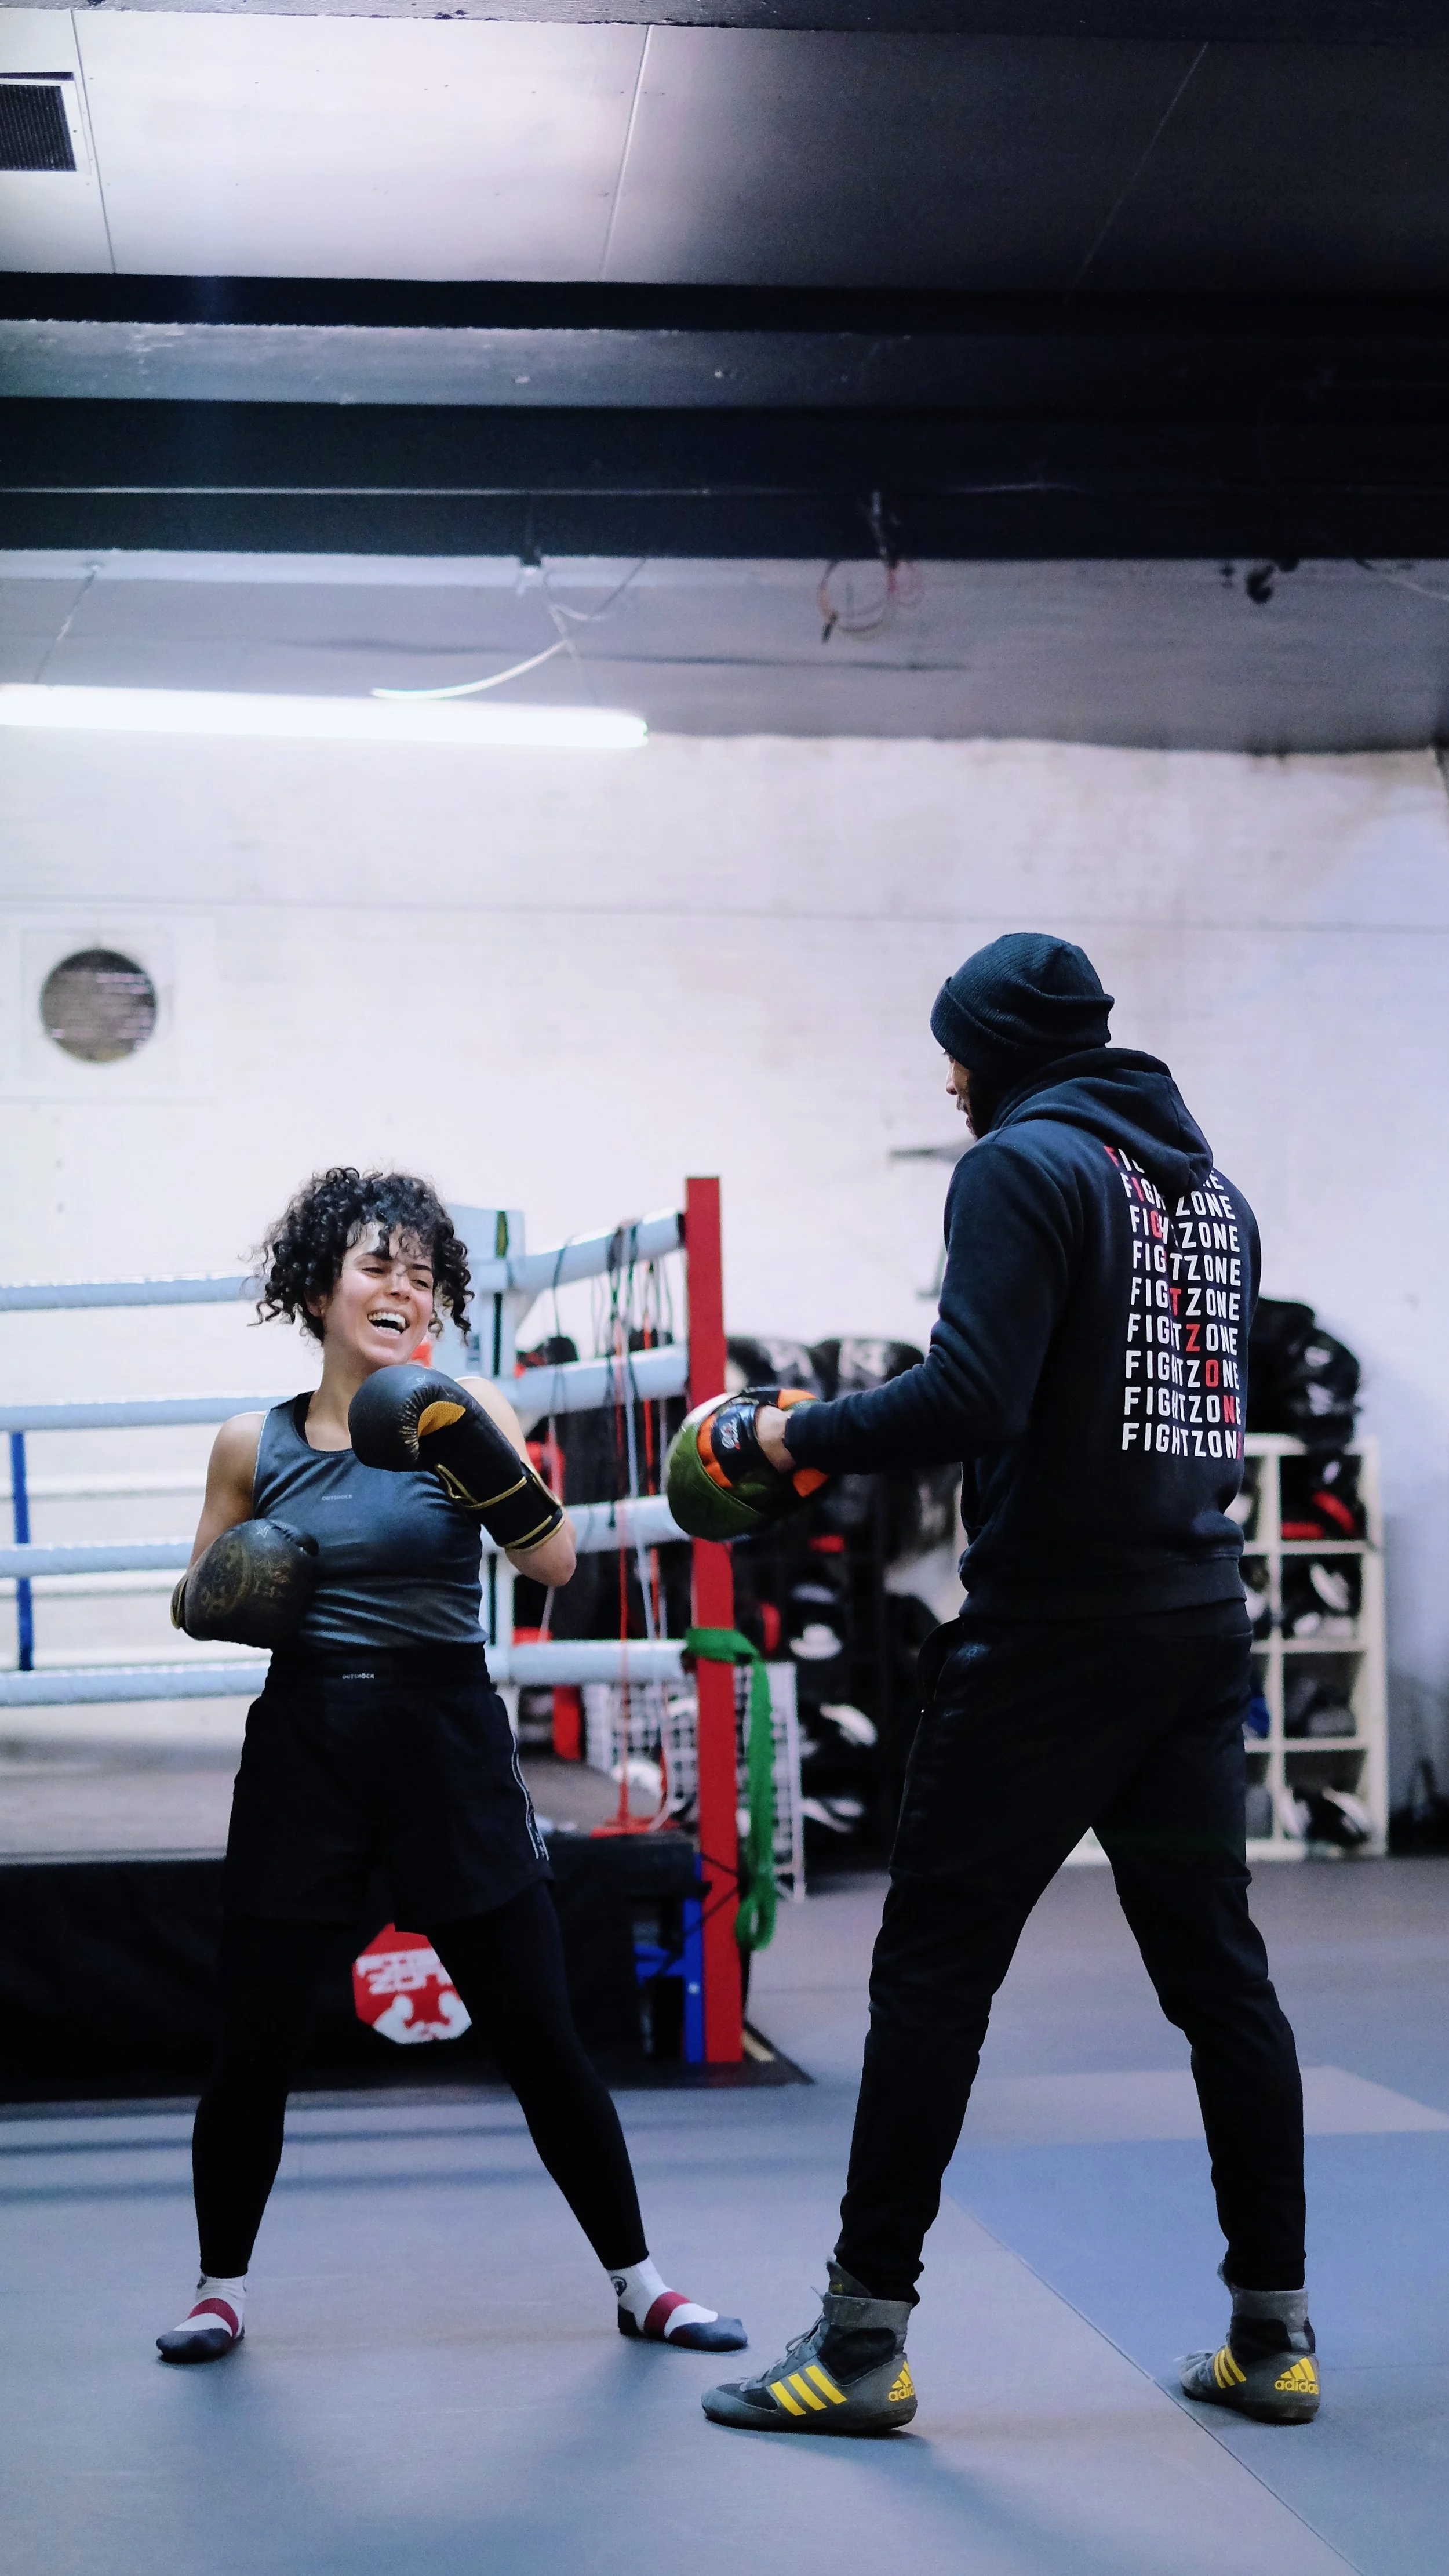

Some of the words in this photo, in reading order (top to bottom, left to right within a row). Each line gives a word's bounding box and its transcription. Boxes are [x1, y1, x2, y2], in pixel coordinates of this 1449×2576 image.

[1120, 1172, 1236, 1220] FIGHZONE
[1130, 1205, 1240, 1252] FIGHZONE
[1133, 1240, 1241, 1287] FIGTZONE
[1130, 1277, 1241, 1321] FIGTZONE
[1126, 1350, 1240, 1390] FIGHTZONE
[1124, 1386, 1241, 1425] FIGHTZONE
[888, 2384, 914, 2401] adid
